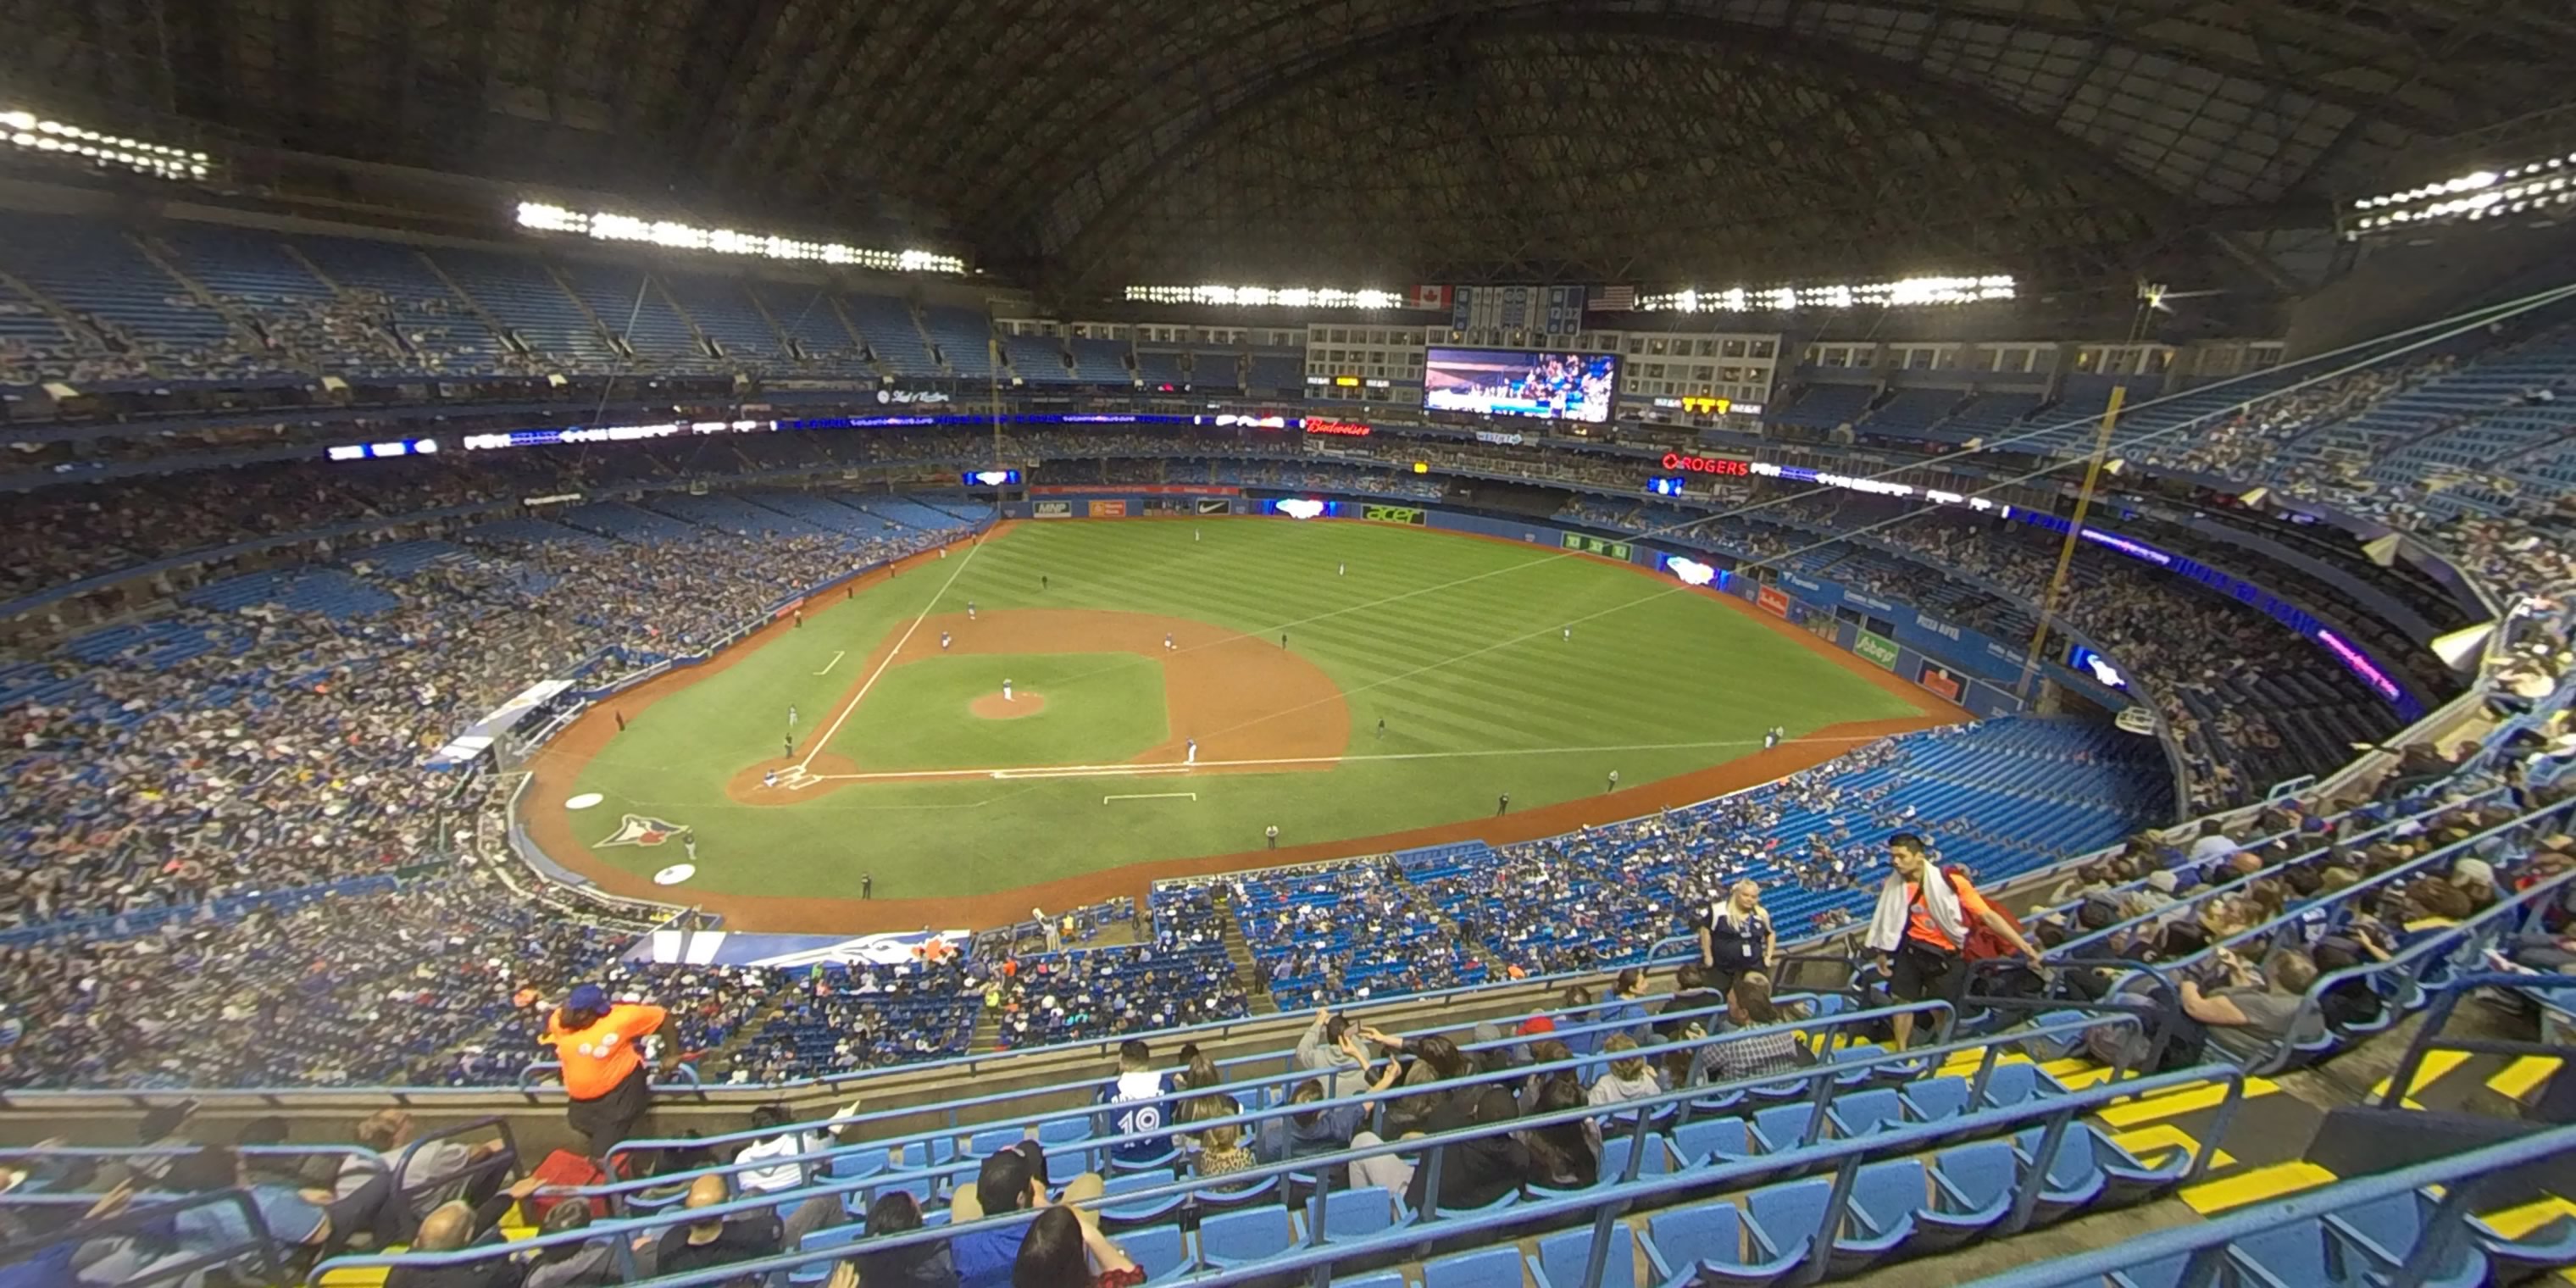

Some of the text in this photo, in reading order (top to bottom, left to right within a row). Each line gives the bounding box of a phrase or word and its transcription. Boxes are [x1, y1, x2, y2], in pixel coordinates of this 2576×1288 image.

[1681, 457, 1748, 476] ROGERS
[1039, 502, 1067, 514] MNP
[1367, 506, 1421, 524] acer
[1118, 1107, 1160, 1147] 19
